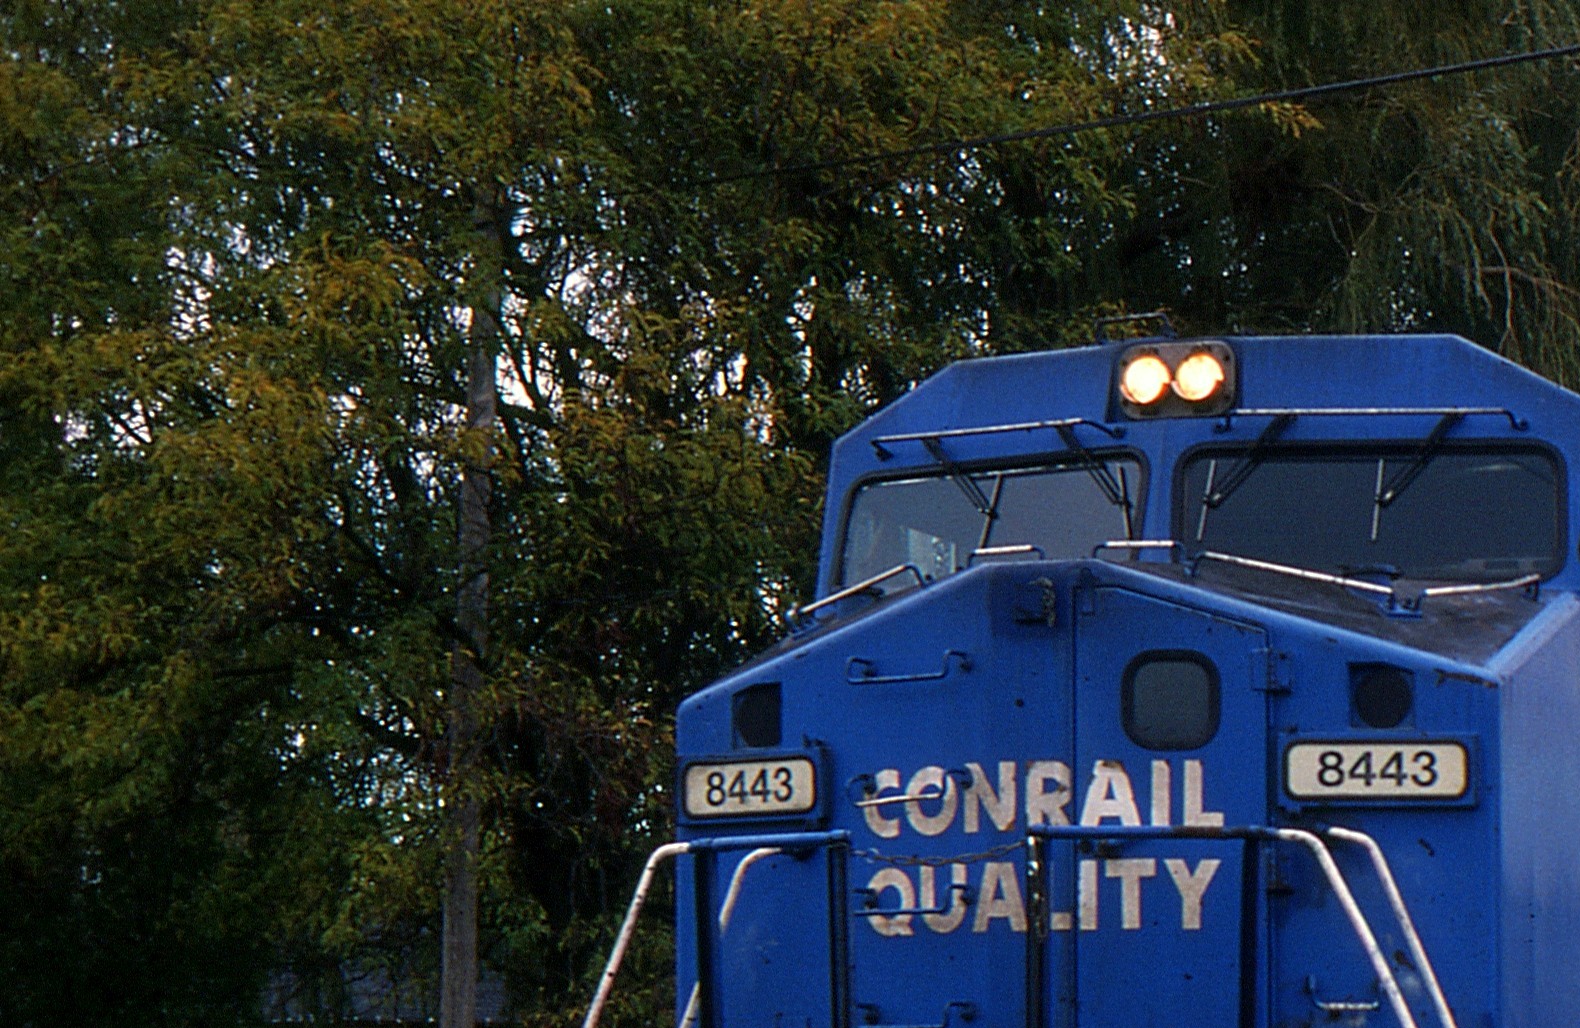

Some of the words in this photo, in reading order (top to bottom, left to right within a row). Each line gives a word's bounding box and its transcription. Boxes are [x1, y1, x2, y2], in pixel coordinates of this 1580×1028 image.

[707, 767, 792, 806] 8443
[1317, 751, 1437, 786] 8443
[863, 760, 1224, 838] CONRAIL
